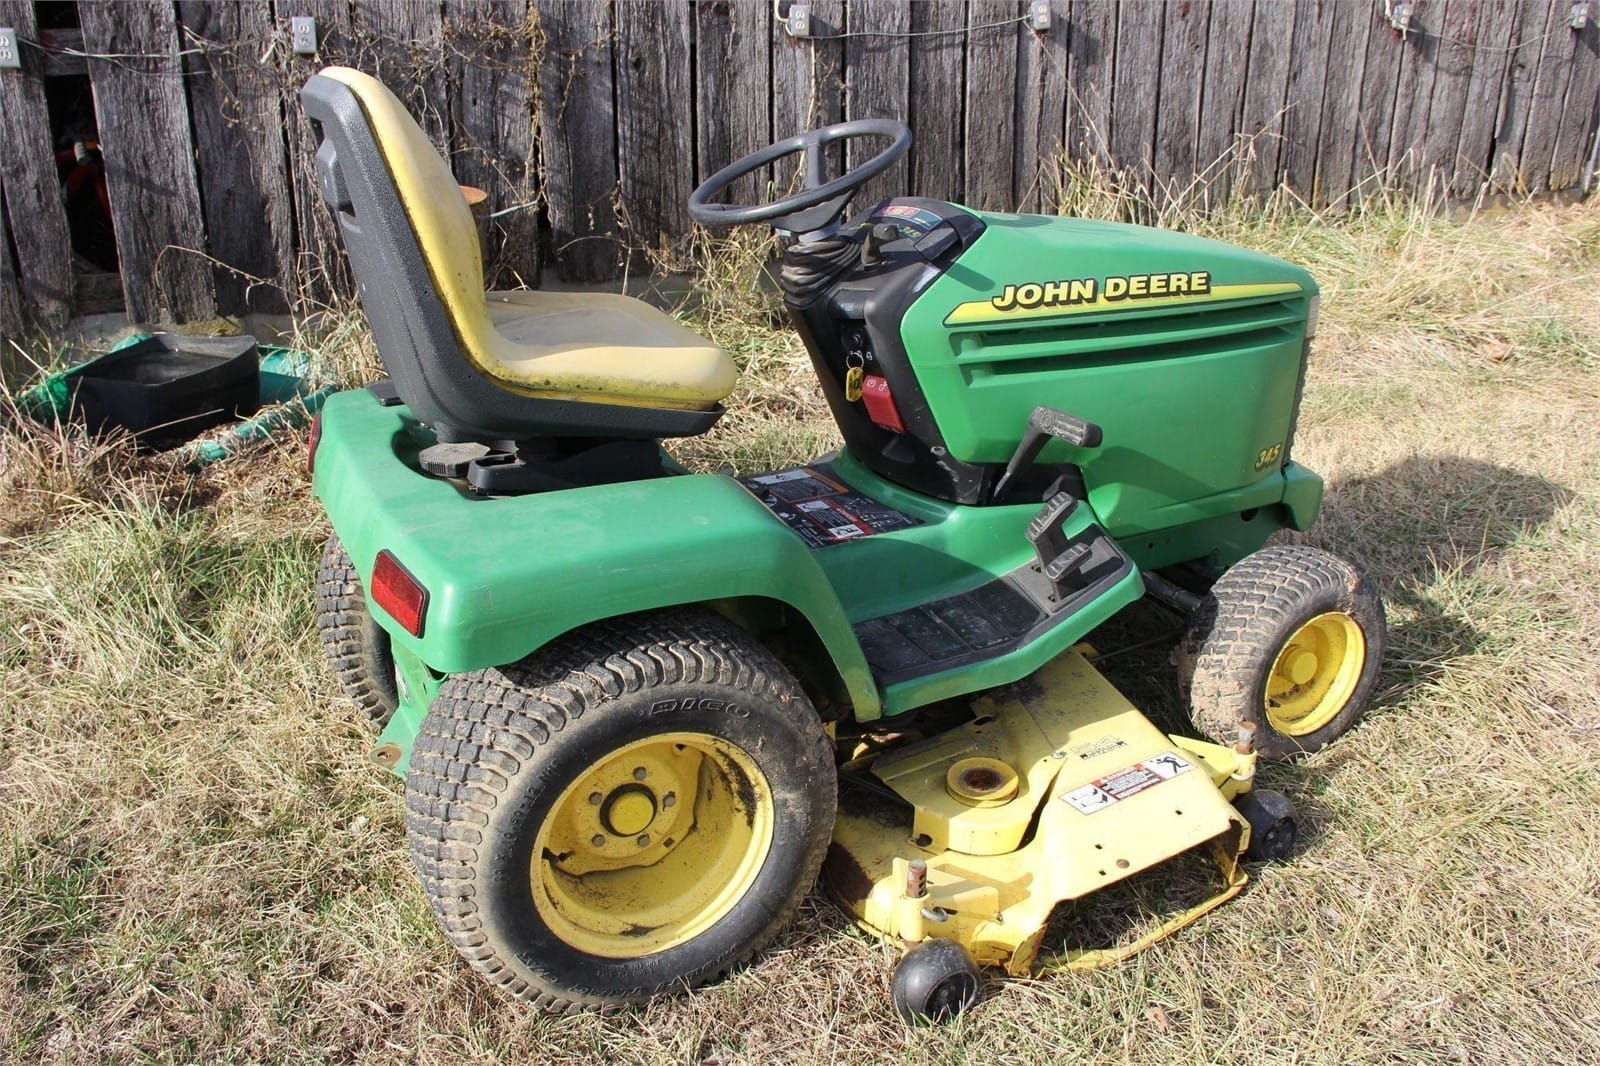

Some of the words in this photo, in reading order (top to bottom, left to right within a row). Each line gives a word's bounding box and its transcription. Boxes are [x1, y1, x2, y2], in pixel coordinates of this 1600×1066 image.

[992, 278, 1098, 311] JOHN
[1103, 271, 1211, 302] DEERE
[1254, 442, 1282, 472] 345
[648, 697, 750, 719] DICO
